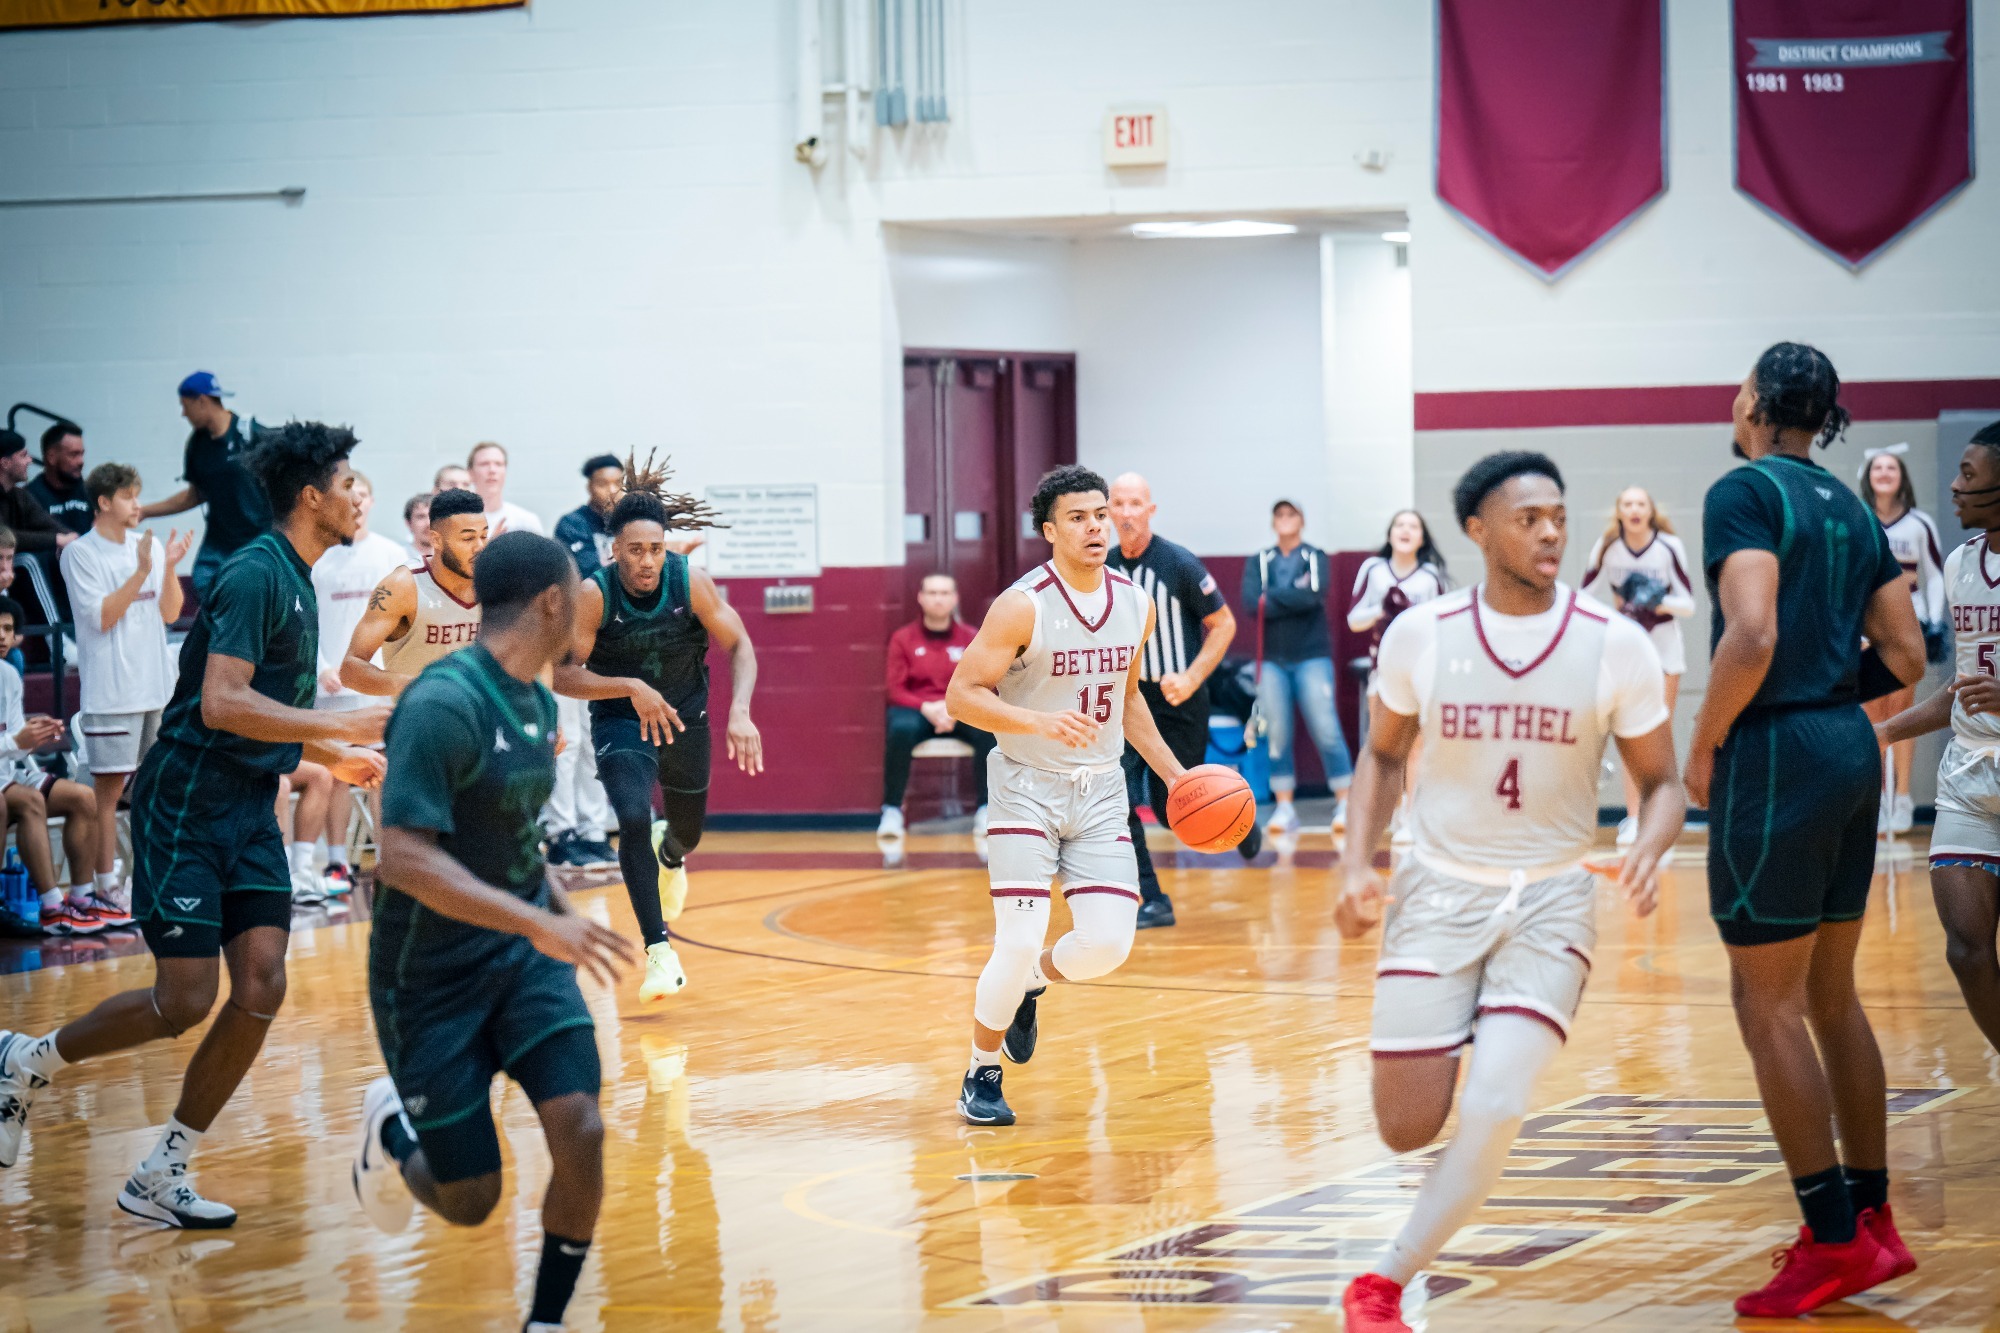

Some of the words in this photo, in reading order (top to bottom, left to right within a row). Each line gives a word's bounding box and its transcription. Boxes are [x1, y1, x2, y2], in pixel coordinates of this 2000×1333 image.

[1778, 45, 1838, 61] DISTRICT
[1840, 41, 1922, 61] CHAMPIONS
[1746, 73, 1787, 92] 1981
[1802, 73, 1844, 92] 1983
[1115, 115, 1153, 147] EXIT
[1077, 682, 1115, 725] 15
[1440, 702, 1577, 745] BETHEL
[1495, 757, 1521, 810] 4
